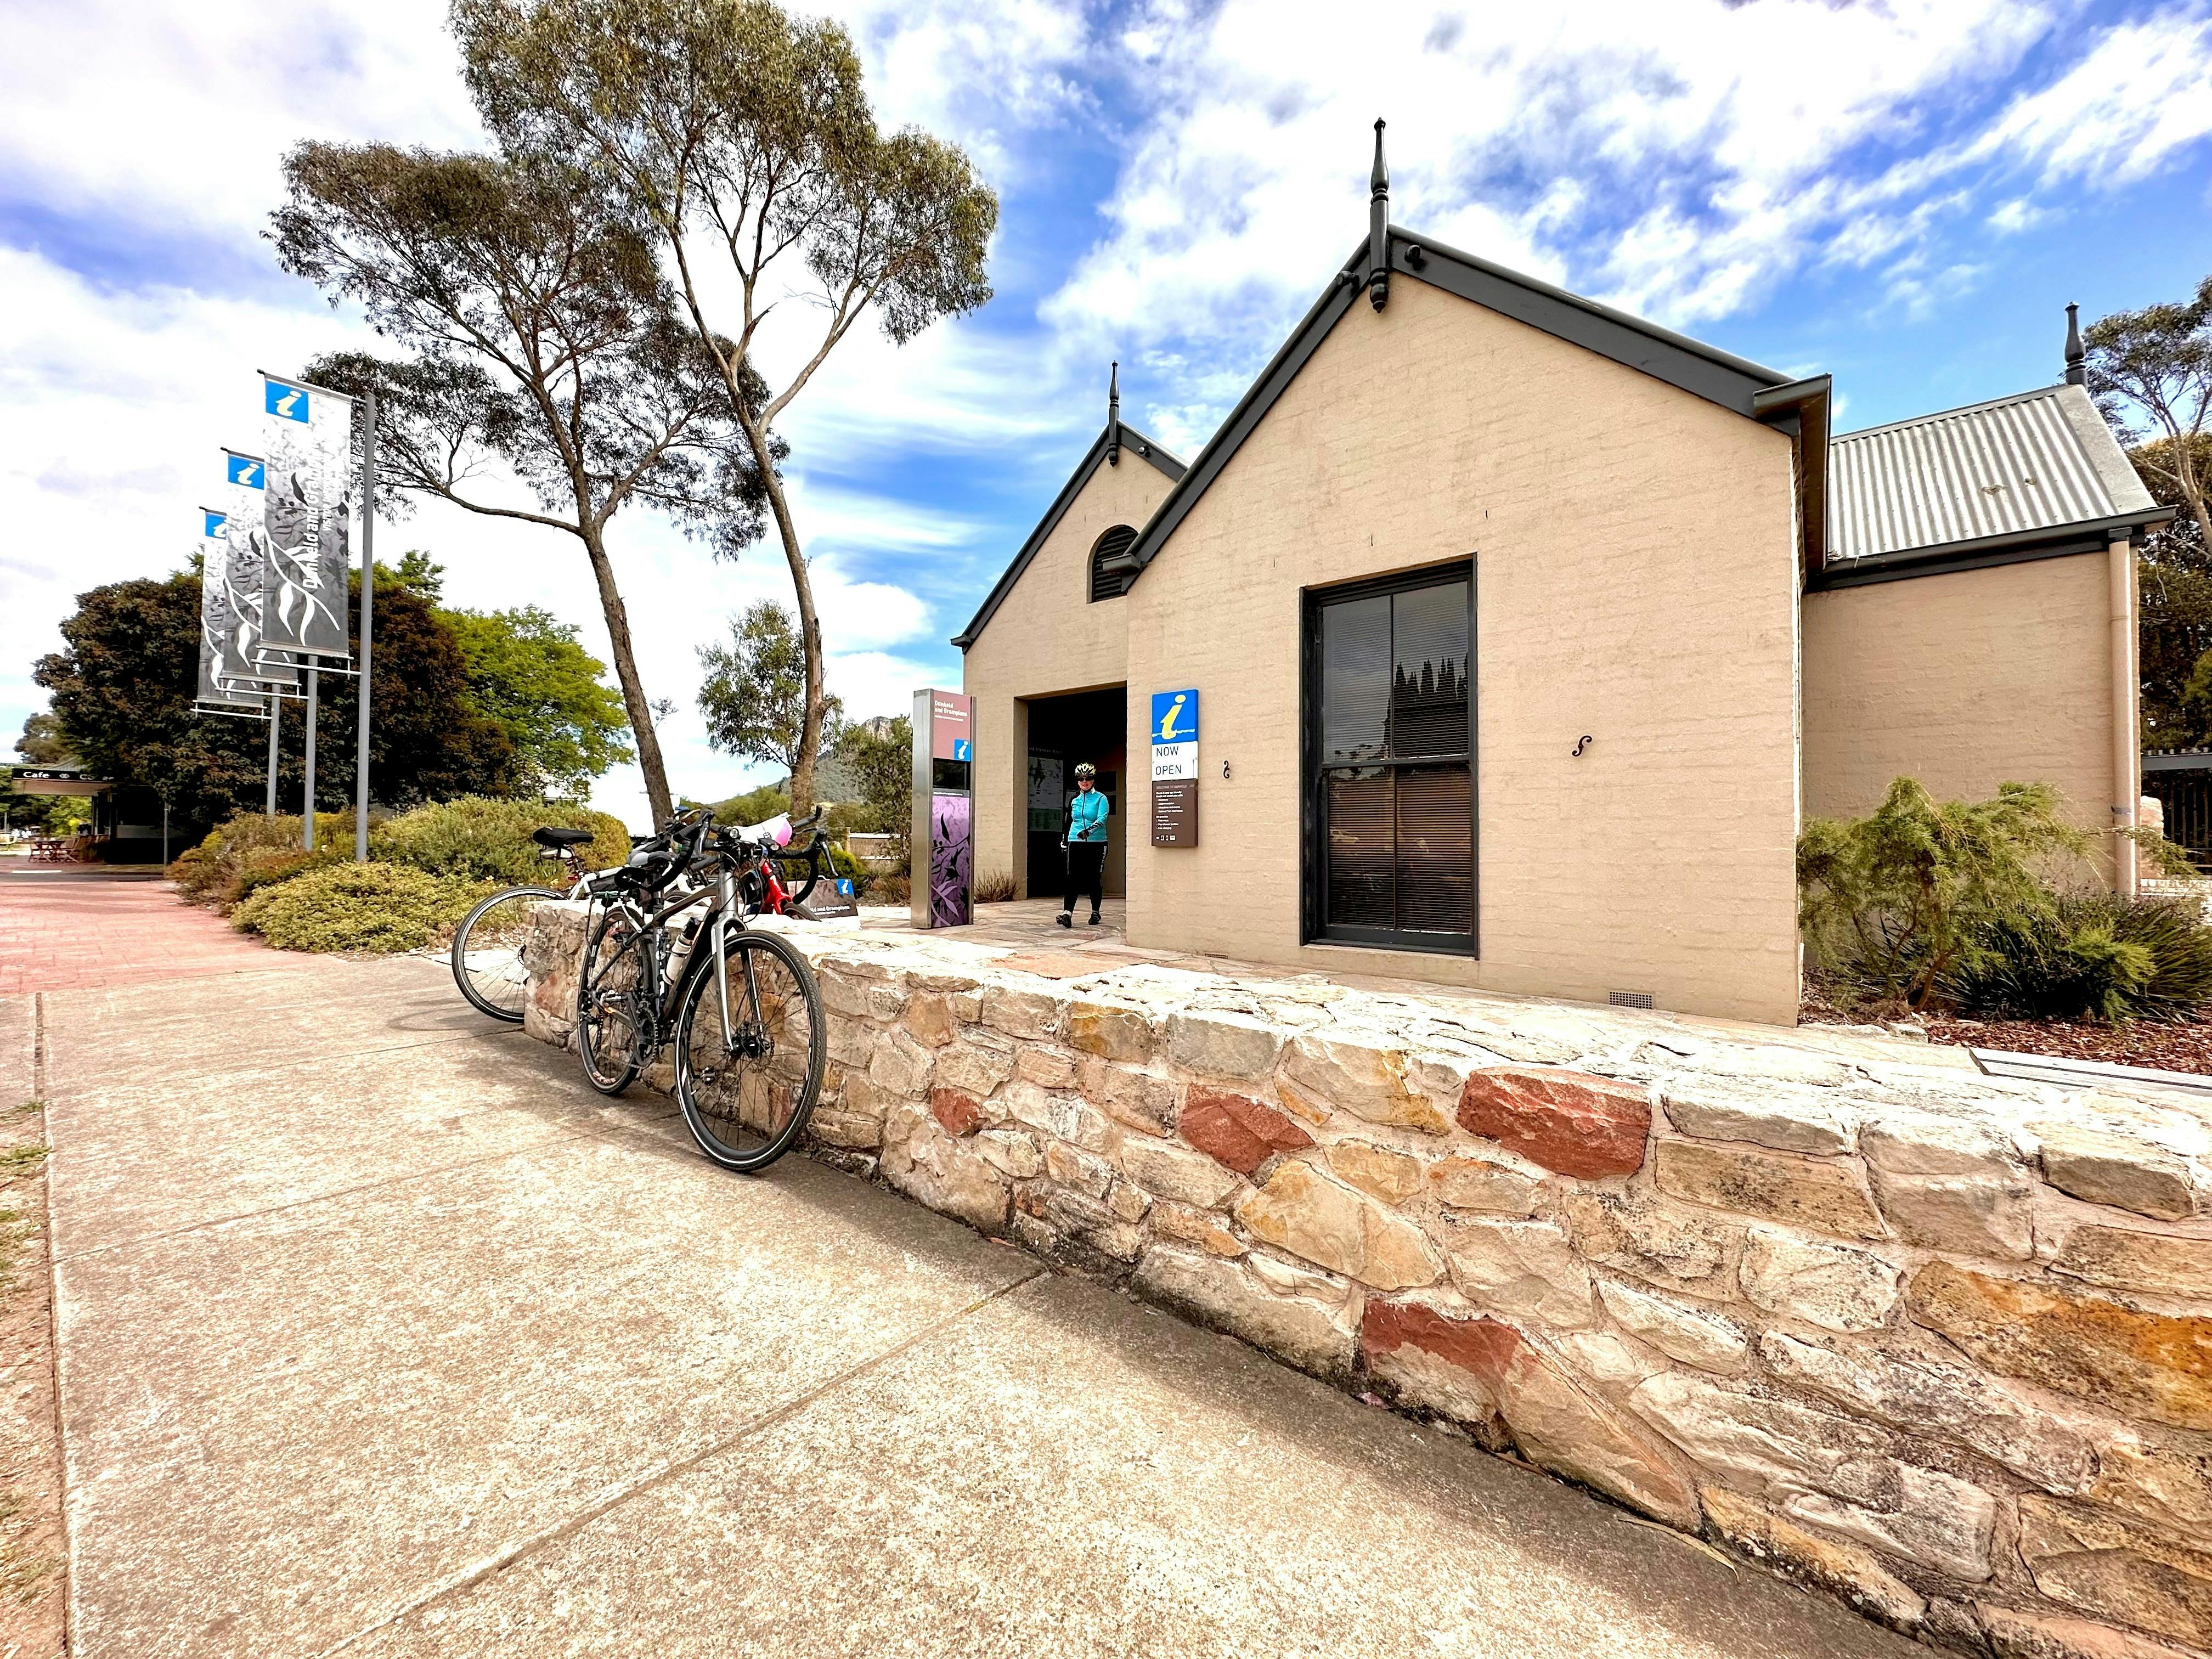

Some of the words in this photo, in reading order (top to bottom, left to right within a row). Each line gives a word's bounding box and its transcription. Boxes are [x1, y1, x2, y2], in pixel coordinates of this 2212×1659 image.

[304, 506, 318, 532] and
[323, 503, 332, 531] VISITOR
[934, 700, 953, 708] Dunkeld
[943, 708, 968, 716] Grampians
[1156, 746, 1178, 757] NOW
[1155, 764, 1182, 775] OPEN
